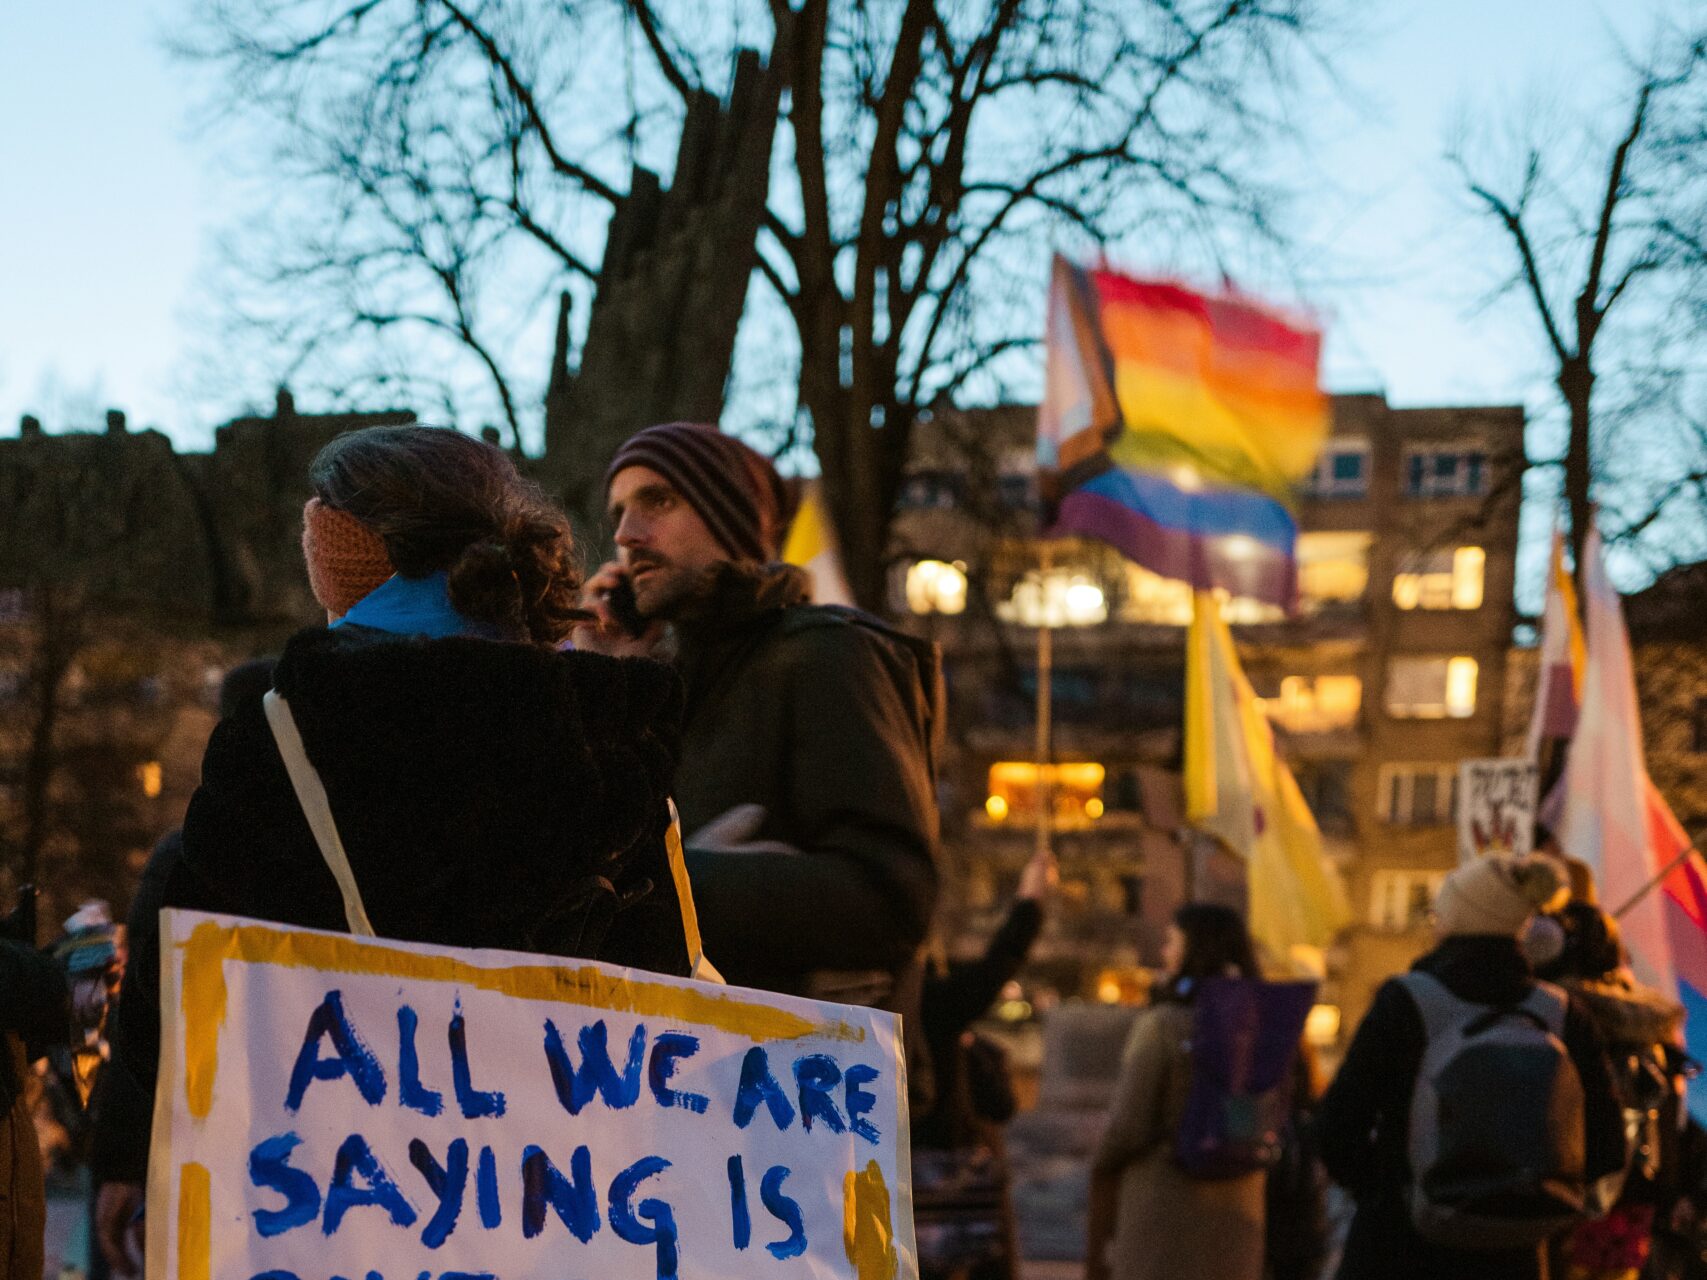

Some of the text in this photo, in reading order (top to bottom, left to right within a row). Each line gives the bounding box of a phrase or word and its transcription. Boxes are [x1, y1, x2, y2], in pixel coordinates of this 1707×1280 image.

[284, 990, 882, 1145] ALL WE ARE
[727, 1154, 808, 1260] IS
